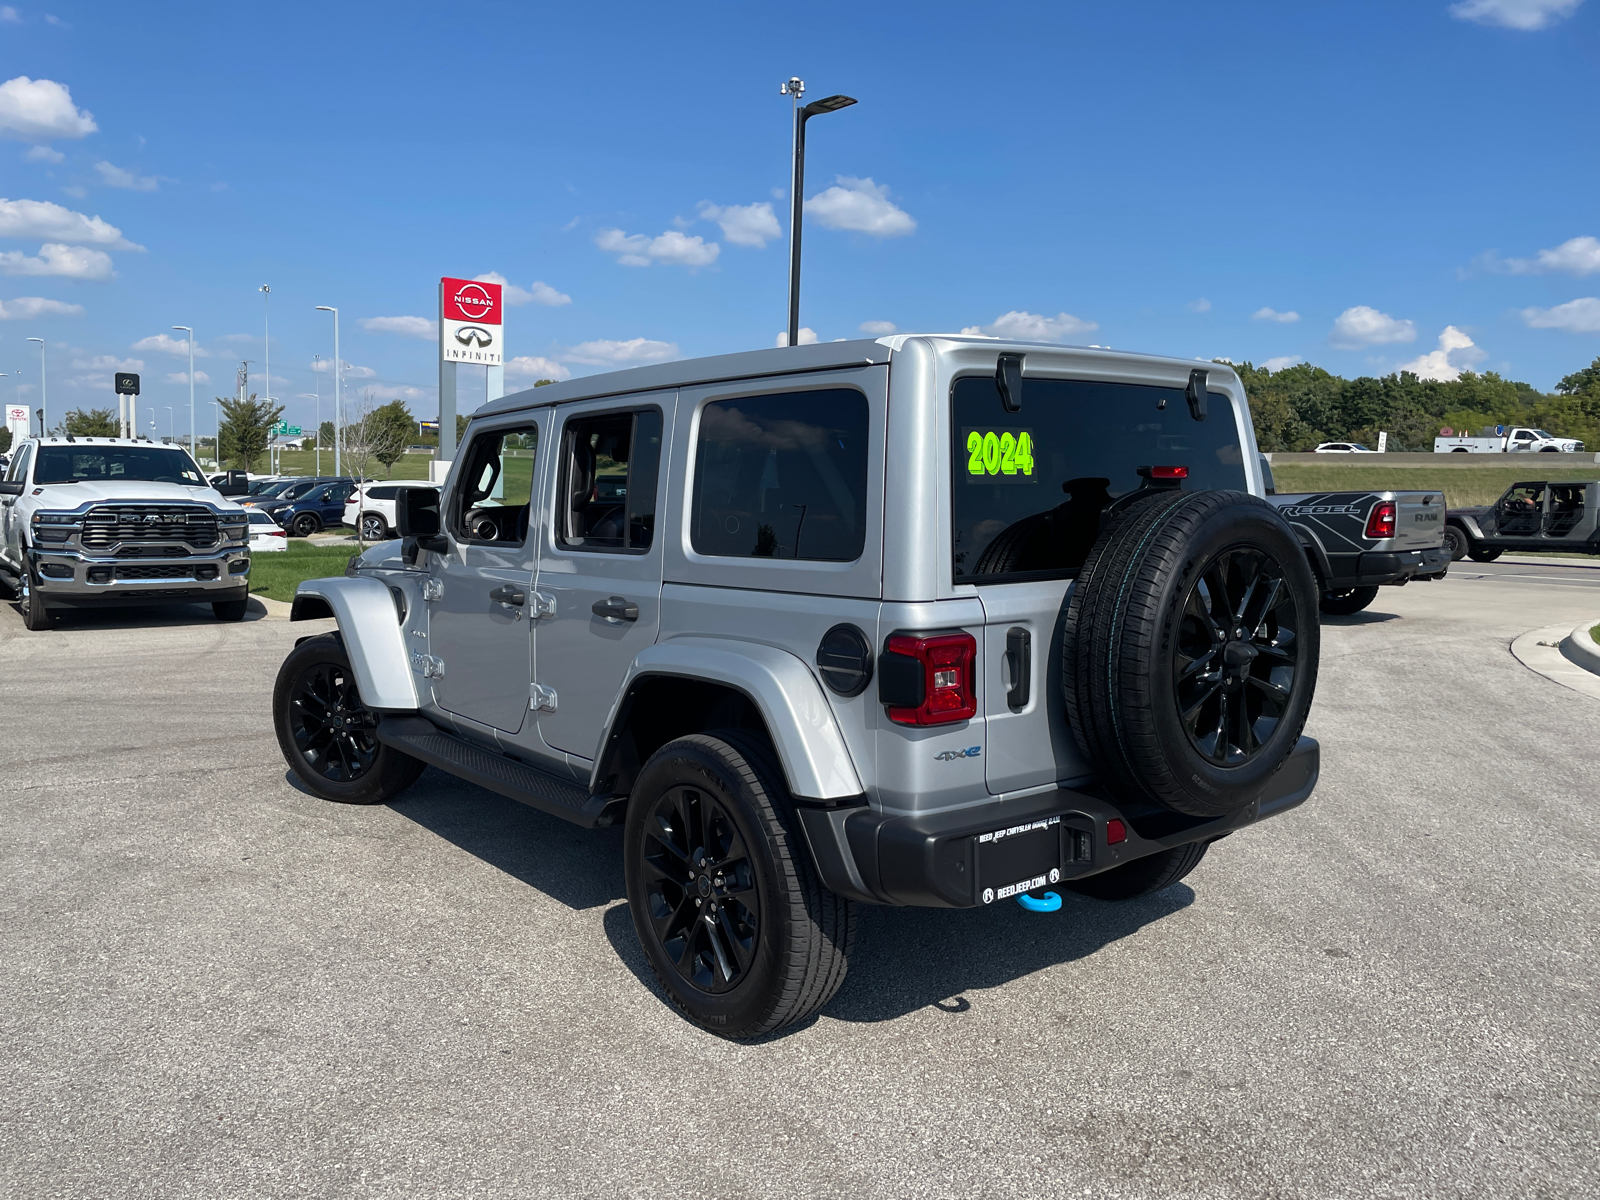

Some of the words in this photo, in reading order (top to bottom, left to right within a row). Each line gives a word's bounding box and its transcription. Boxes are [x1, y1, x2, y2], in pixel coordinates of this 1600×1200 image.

[454, 295, 493, 307] NISSAN
[447, 349, 500, 362] INFINITI
[967, 431, 1034, 475] 2024
[1278, 504, 1361, 517] REBEL
[120, 514, 185, 523] RAM
[1414, 513, 1438, 522] RAM
[1161, 560, 1194, 650] NEXEN
[979, 833, 993, 843] REED
[994, 830, 1006, 839] JEEP
[1007, 823, 1031, 835] CHRYSLER
[1032, 819, 1048, 829] DODGE
[1049, 816, 1060, 825] RAM
[998, 876, 1046, 899] REEDJEEP.COM
